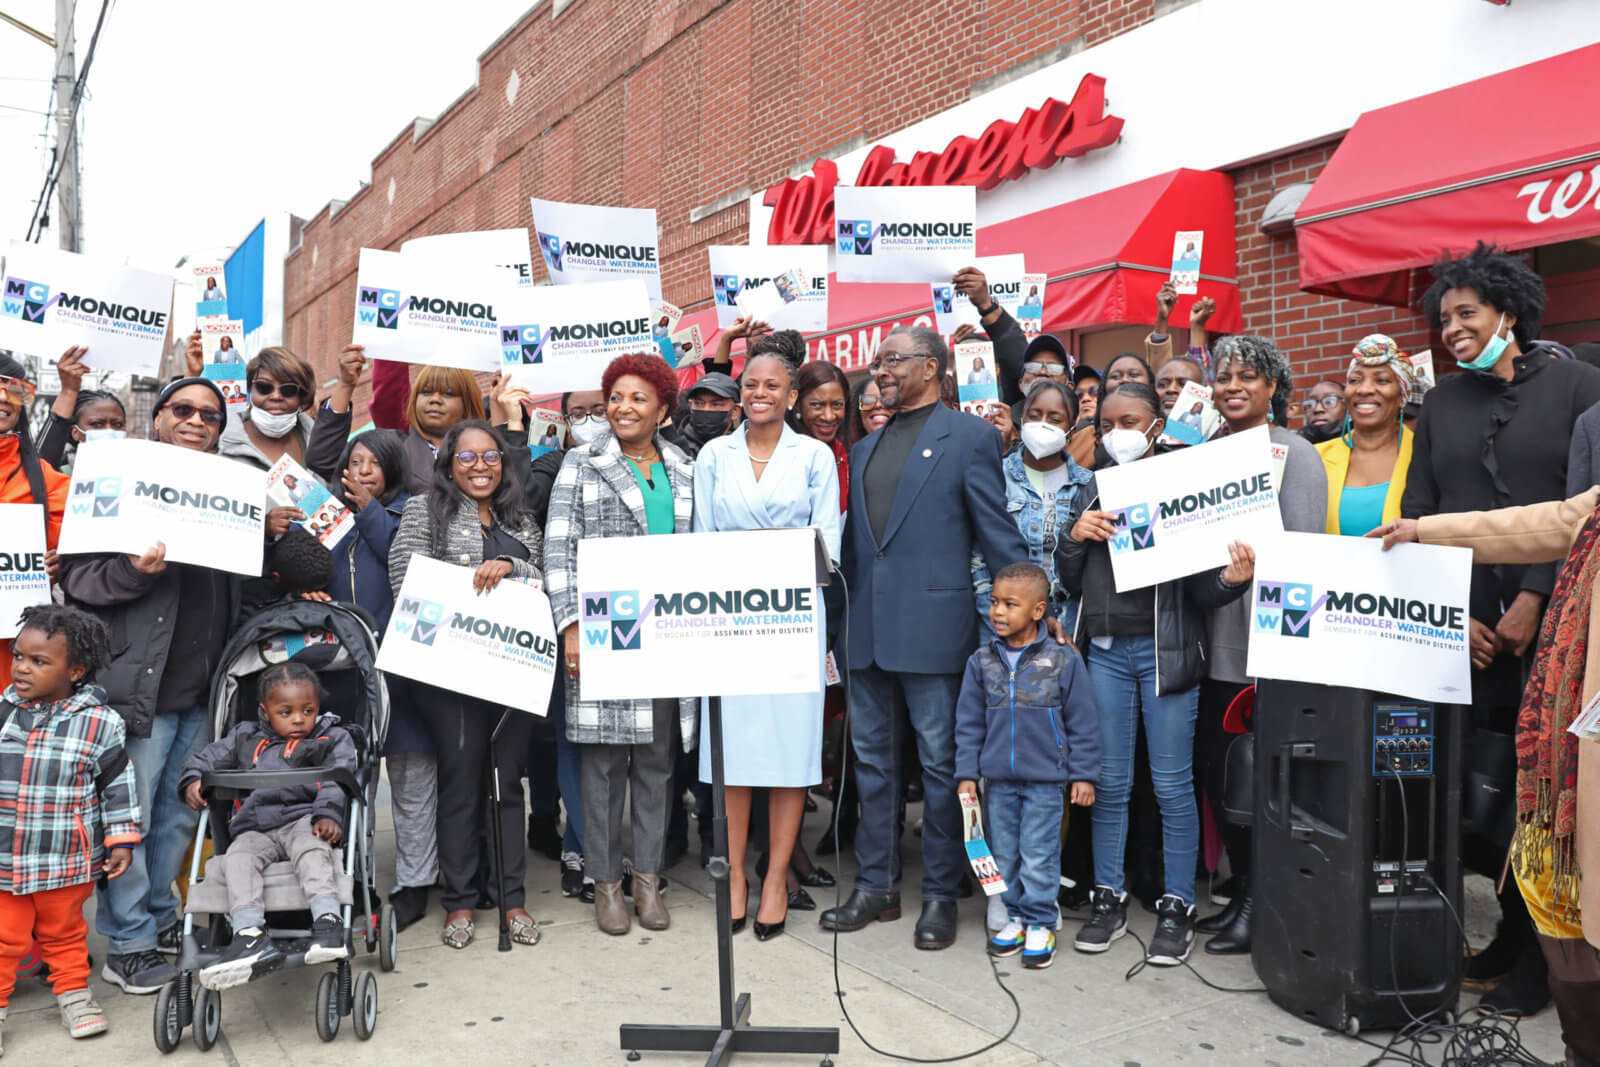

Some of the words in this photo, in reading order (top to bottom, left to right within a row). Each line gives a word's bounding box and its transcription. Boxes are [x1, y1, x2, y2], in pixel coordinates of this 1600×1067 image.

[880, 222, 973, 237] MONIQUE
[566, 241, 656, 261] MONIQUE
[567, 257, 607, 266] CHANDLER
[609, 259, 657, 269] WATERMAN
[56, 309, 109, 325] CHANDLER
[112, 320, 164, 336] WATERMAN
[58, 292, 167, 328] MONIQUE
[409, 312, 456, 323] CHANDLER
[550, 317, 650, 342] MONIQUE
[552, 340, 600, 350] CHANDLER
[602, 334, 650, 346] WATERMAN
[135, 481, 262, 522] MONIQUE
[1159, 472, 1272, 520] MONIQUE
[1162, 509, 1213, 529] CHANDLER
[1216, 492, 1274, 513] WATERMAN
[654, 588, 812, 617] MONIQUE
[1325, 590, 1464, 630] MONIQUE
[655, 616, 727, 630] CHANDLER
[732, 613, 813, 626] WATERMAN
[714, 629, 752, 637] ASSEMBLY
[779, 626, 813, 635] DISTRICT
[1325, 614, 1392, 629] CHANDLER
[1396, 622, 1464, 642] WATERMAN
[451, 612, 556, 659] MONIQUE
[504, 645, 554, 668] WATERMAN
